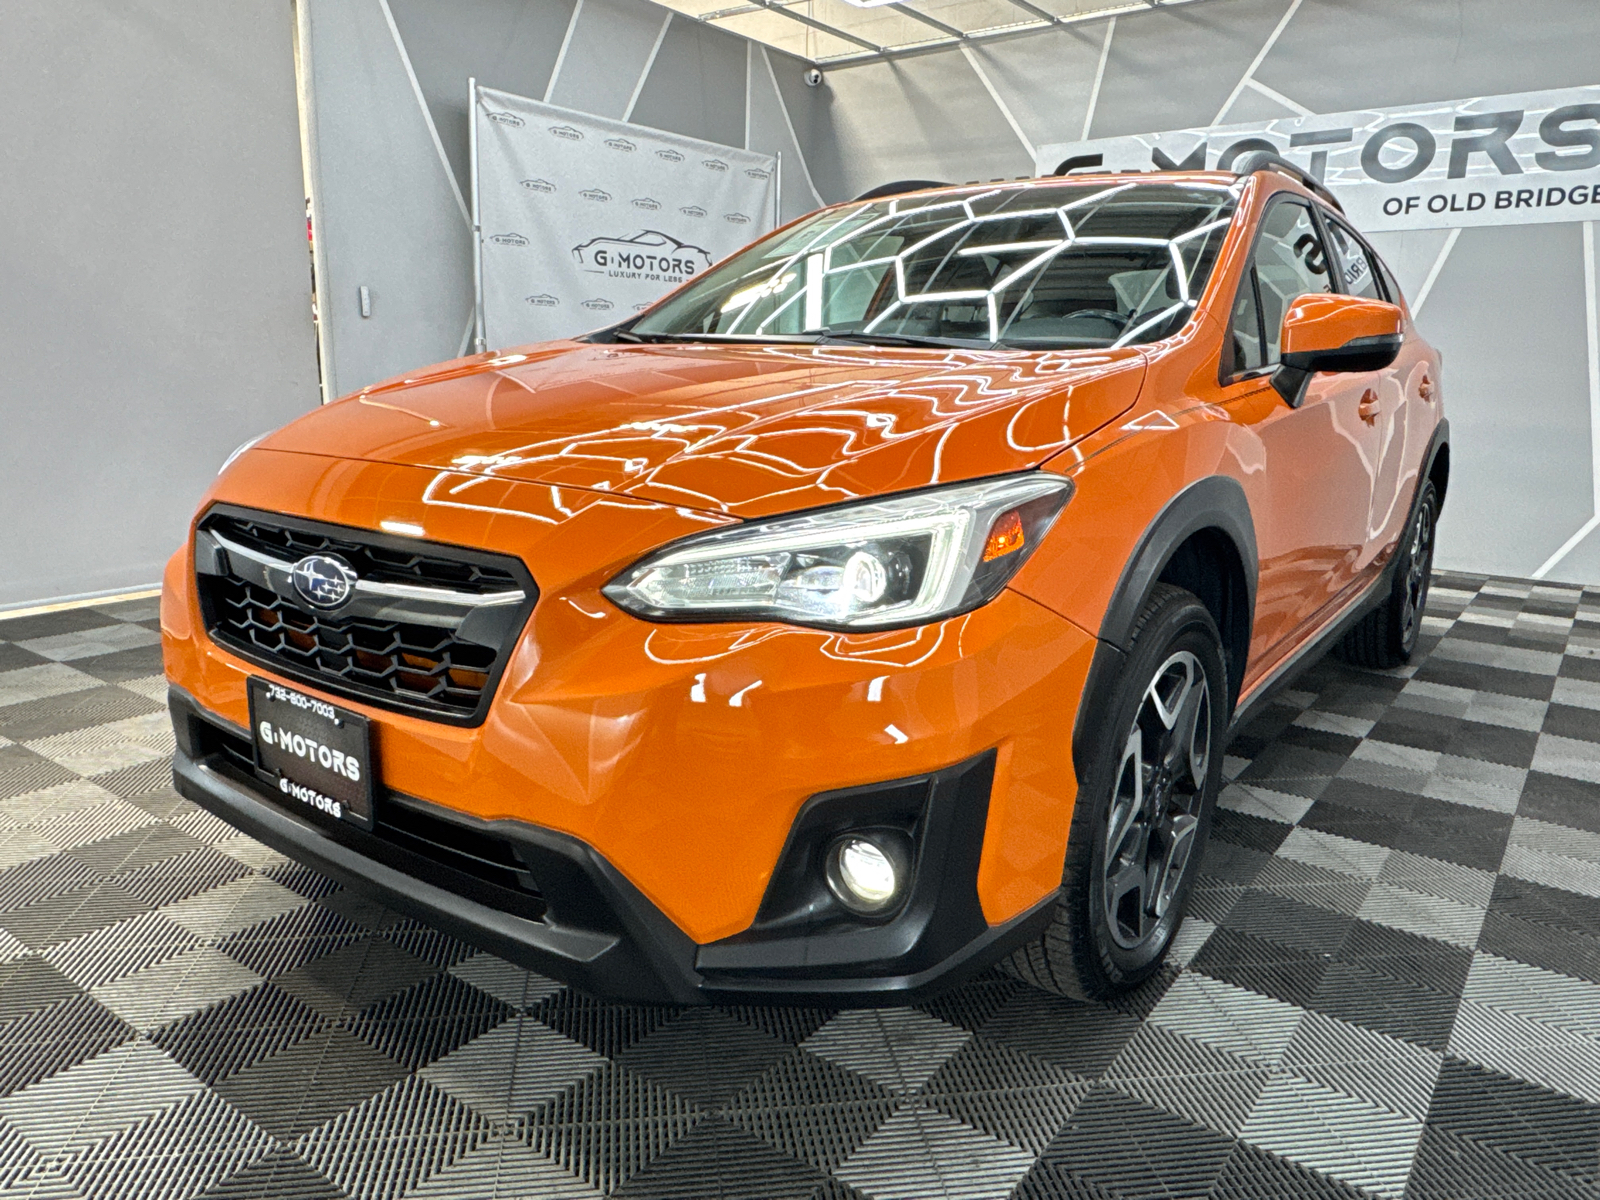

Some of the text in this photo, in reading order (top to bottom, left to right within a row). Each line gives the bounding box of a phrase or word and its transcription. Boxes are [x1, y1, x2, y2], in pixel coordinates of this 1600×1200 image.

[1382, 196, 1421, 216] OF
[1426, 192, 1486, 214] OLD
[608, 270, 683, 283] LUXURY FOR LESS
